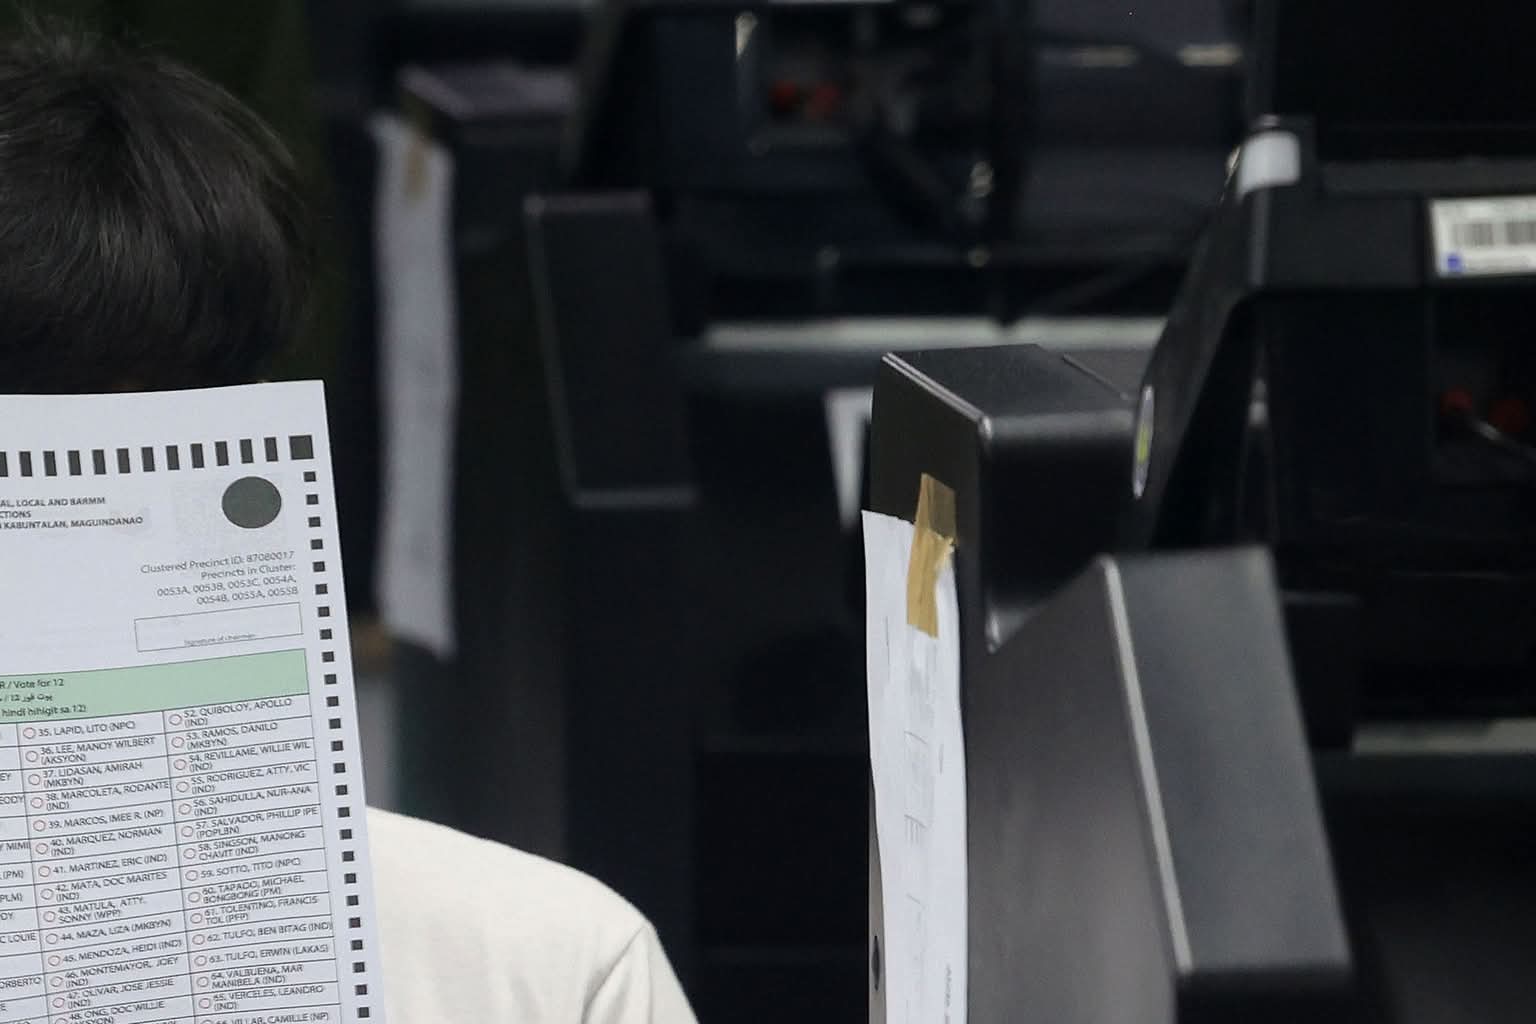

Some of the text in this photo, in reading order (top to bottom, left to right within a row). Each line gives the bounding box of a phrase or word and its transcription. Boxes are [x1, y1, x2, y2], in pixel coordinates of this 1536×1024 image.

[16, 499, 45, 507] LOCAL
[70, 497, 105, 505] BARMM
[71, 517, 143, 527] MAGUINDANAO
[141, 551, 294, 573] Clustered Precinct ID: 87080017
[201, 569, 244, 579] Precincts
[259, 564, 296, 573] Cluster:
[14, 680, 35, 688] Vote
[255, 698, 292, 709] APOLLO
[87, 724, 107, 733] LITO
[109, 721, 136, 731] (NPC)
[185, 718, 208, 728] (IND)
